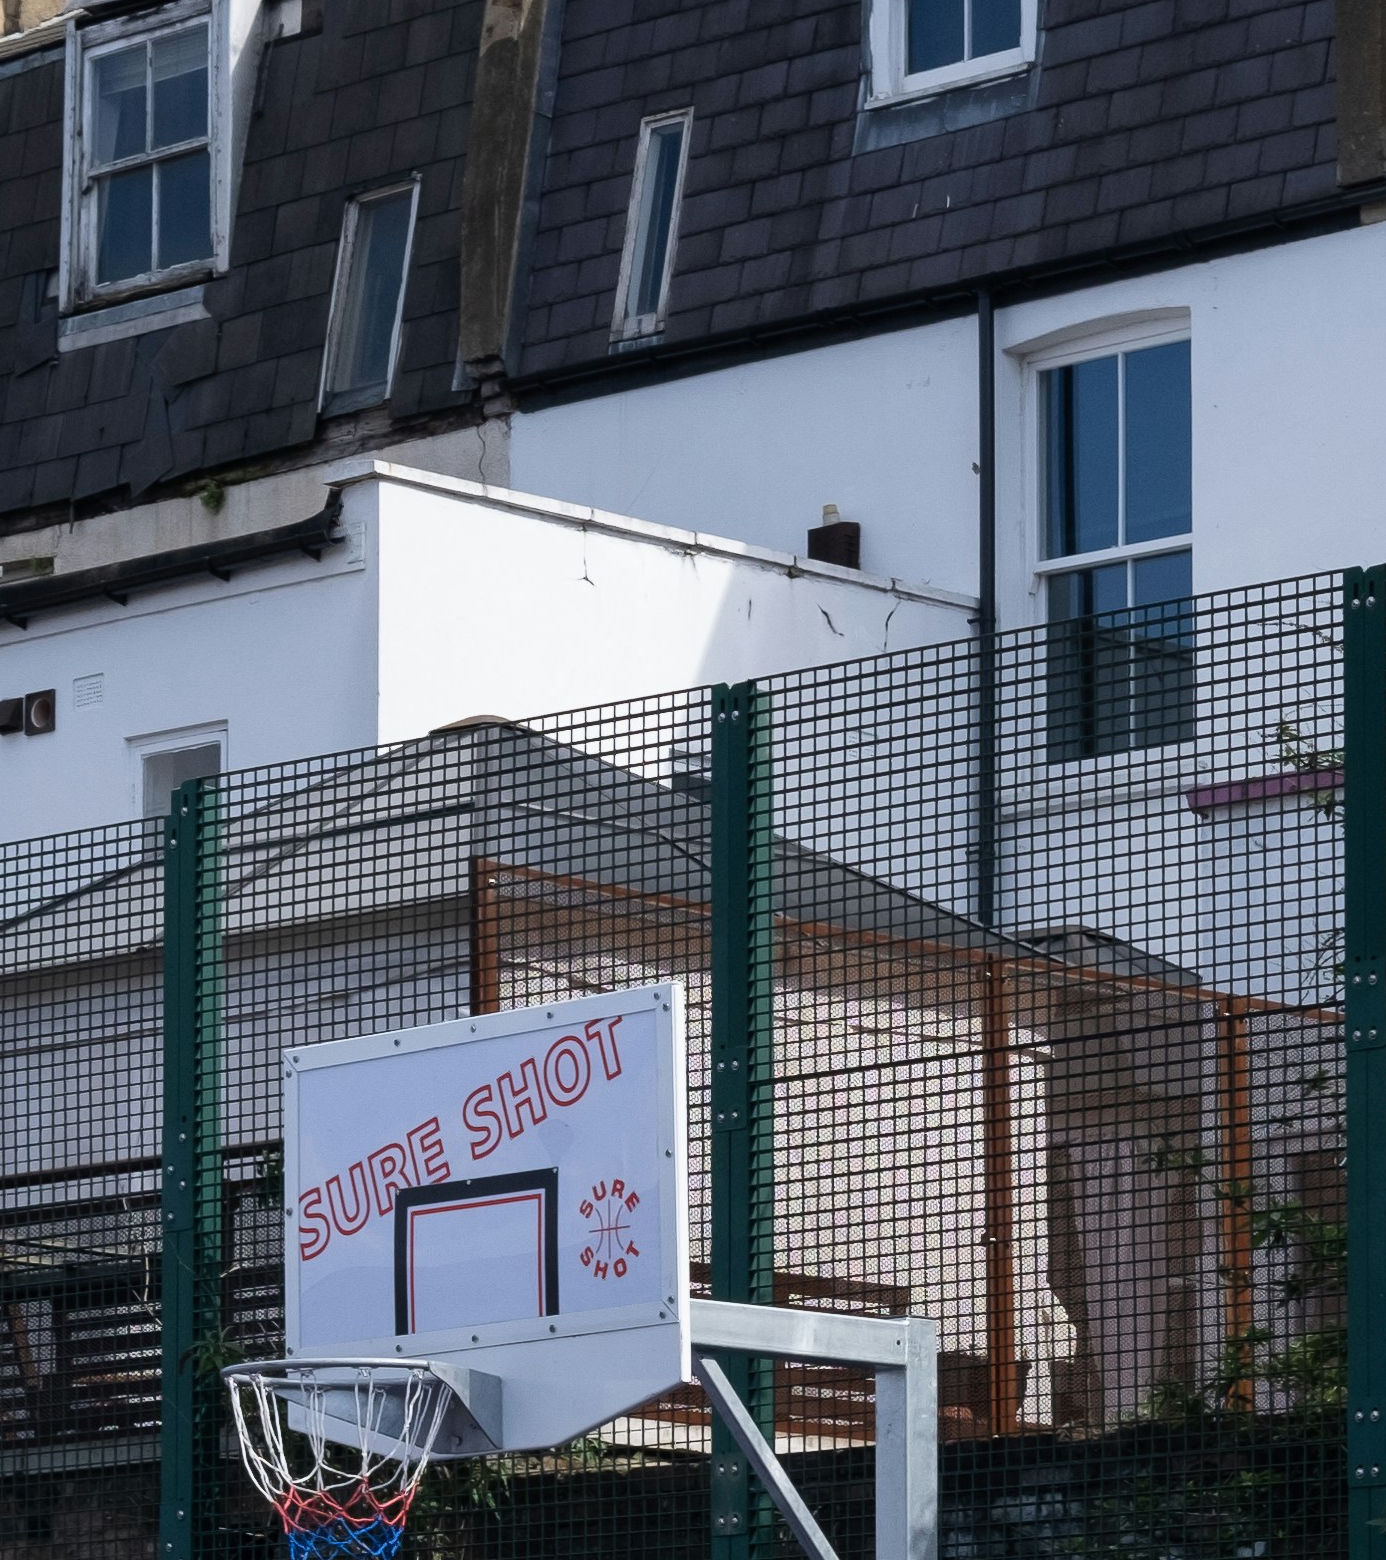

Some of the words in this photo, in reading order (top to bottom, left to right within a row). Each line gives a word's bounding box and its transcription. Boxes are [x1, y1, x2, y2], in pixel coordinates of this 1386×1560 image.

[298, 1115, 452, 1262] SURE
[462, 1015, 624, 1161] SHOT
[579, 1178, 641, 1219] SURE
[579, 1240, 640, 1281] SHOT
